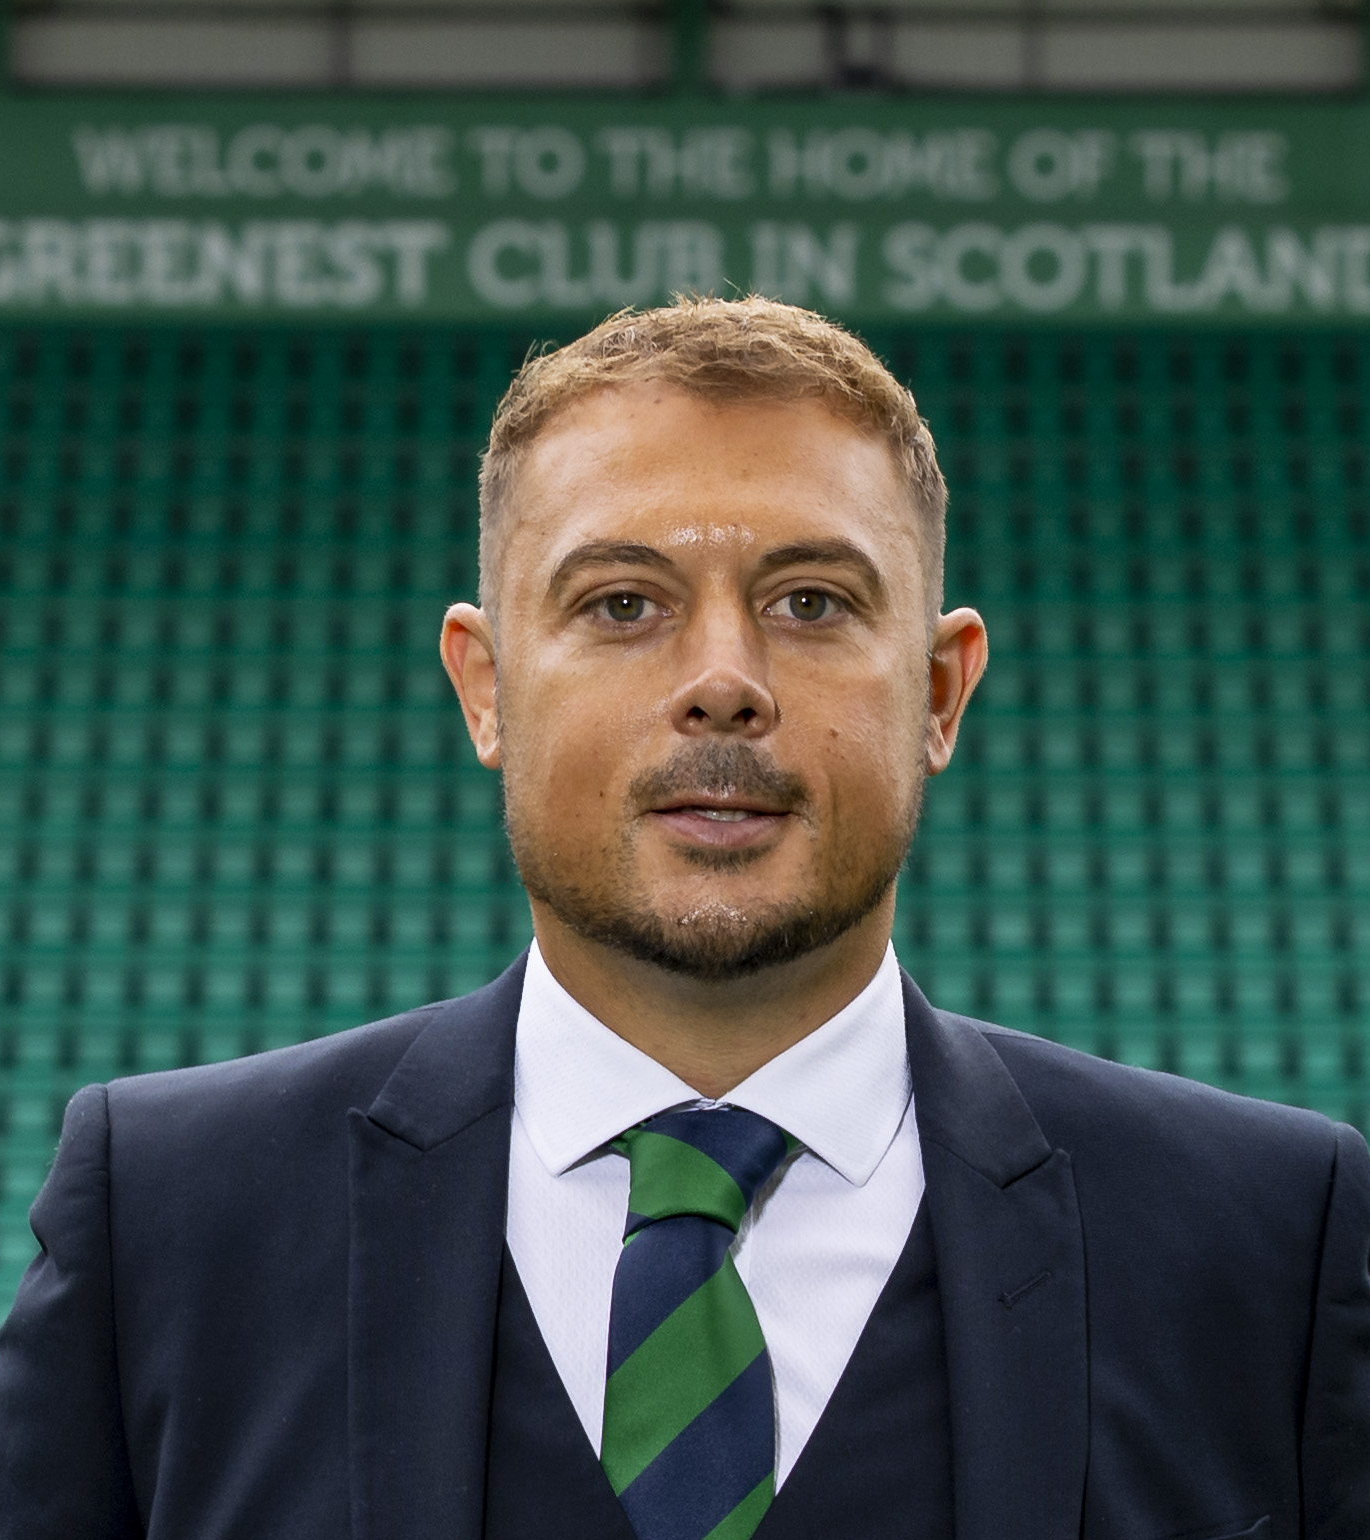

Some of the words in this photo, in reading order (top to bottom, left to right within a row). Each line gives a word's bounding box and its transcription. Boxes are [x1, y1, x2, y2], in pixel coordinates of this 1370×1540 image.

[74, 124, 457, 199] WELCOME
[468, 125, 586, 200] TO
[603, 126, 754, 200] THE
[768, 126, 999, 201] HOME
[1008, 126, 1115, 202] OF
[1133, 128, 1290, 202] THE
[467, 218, 723, 310] CLUB
[751, 221, 860, 306] IN
